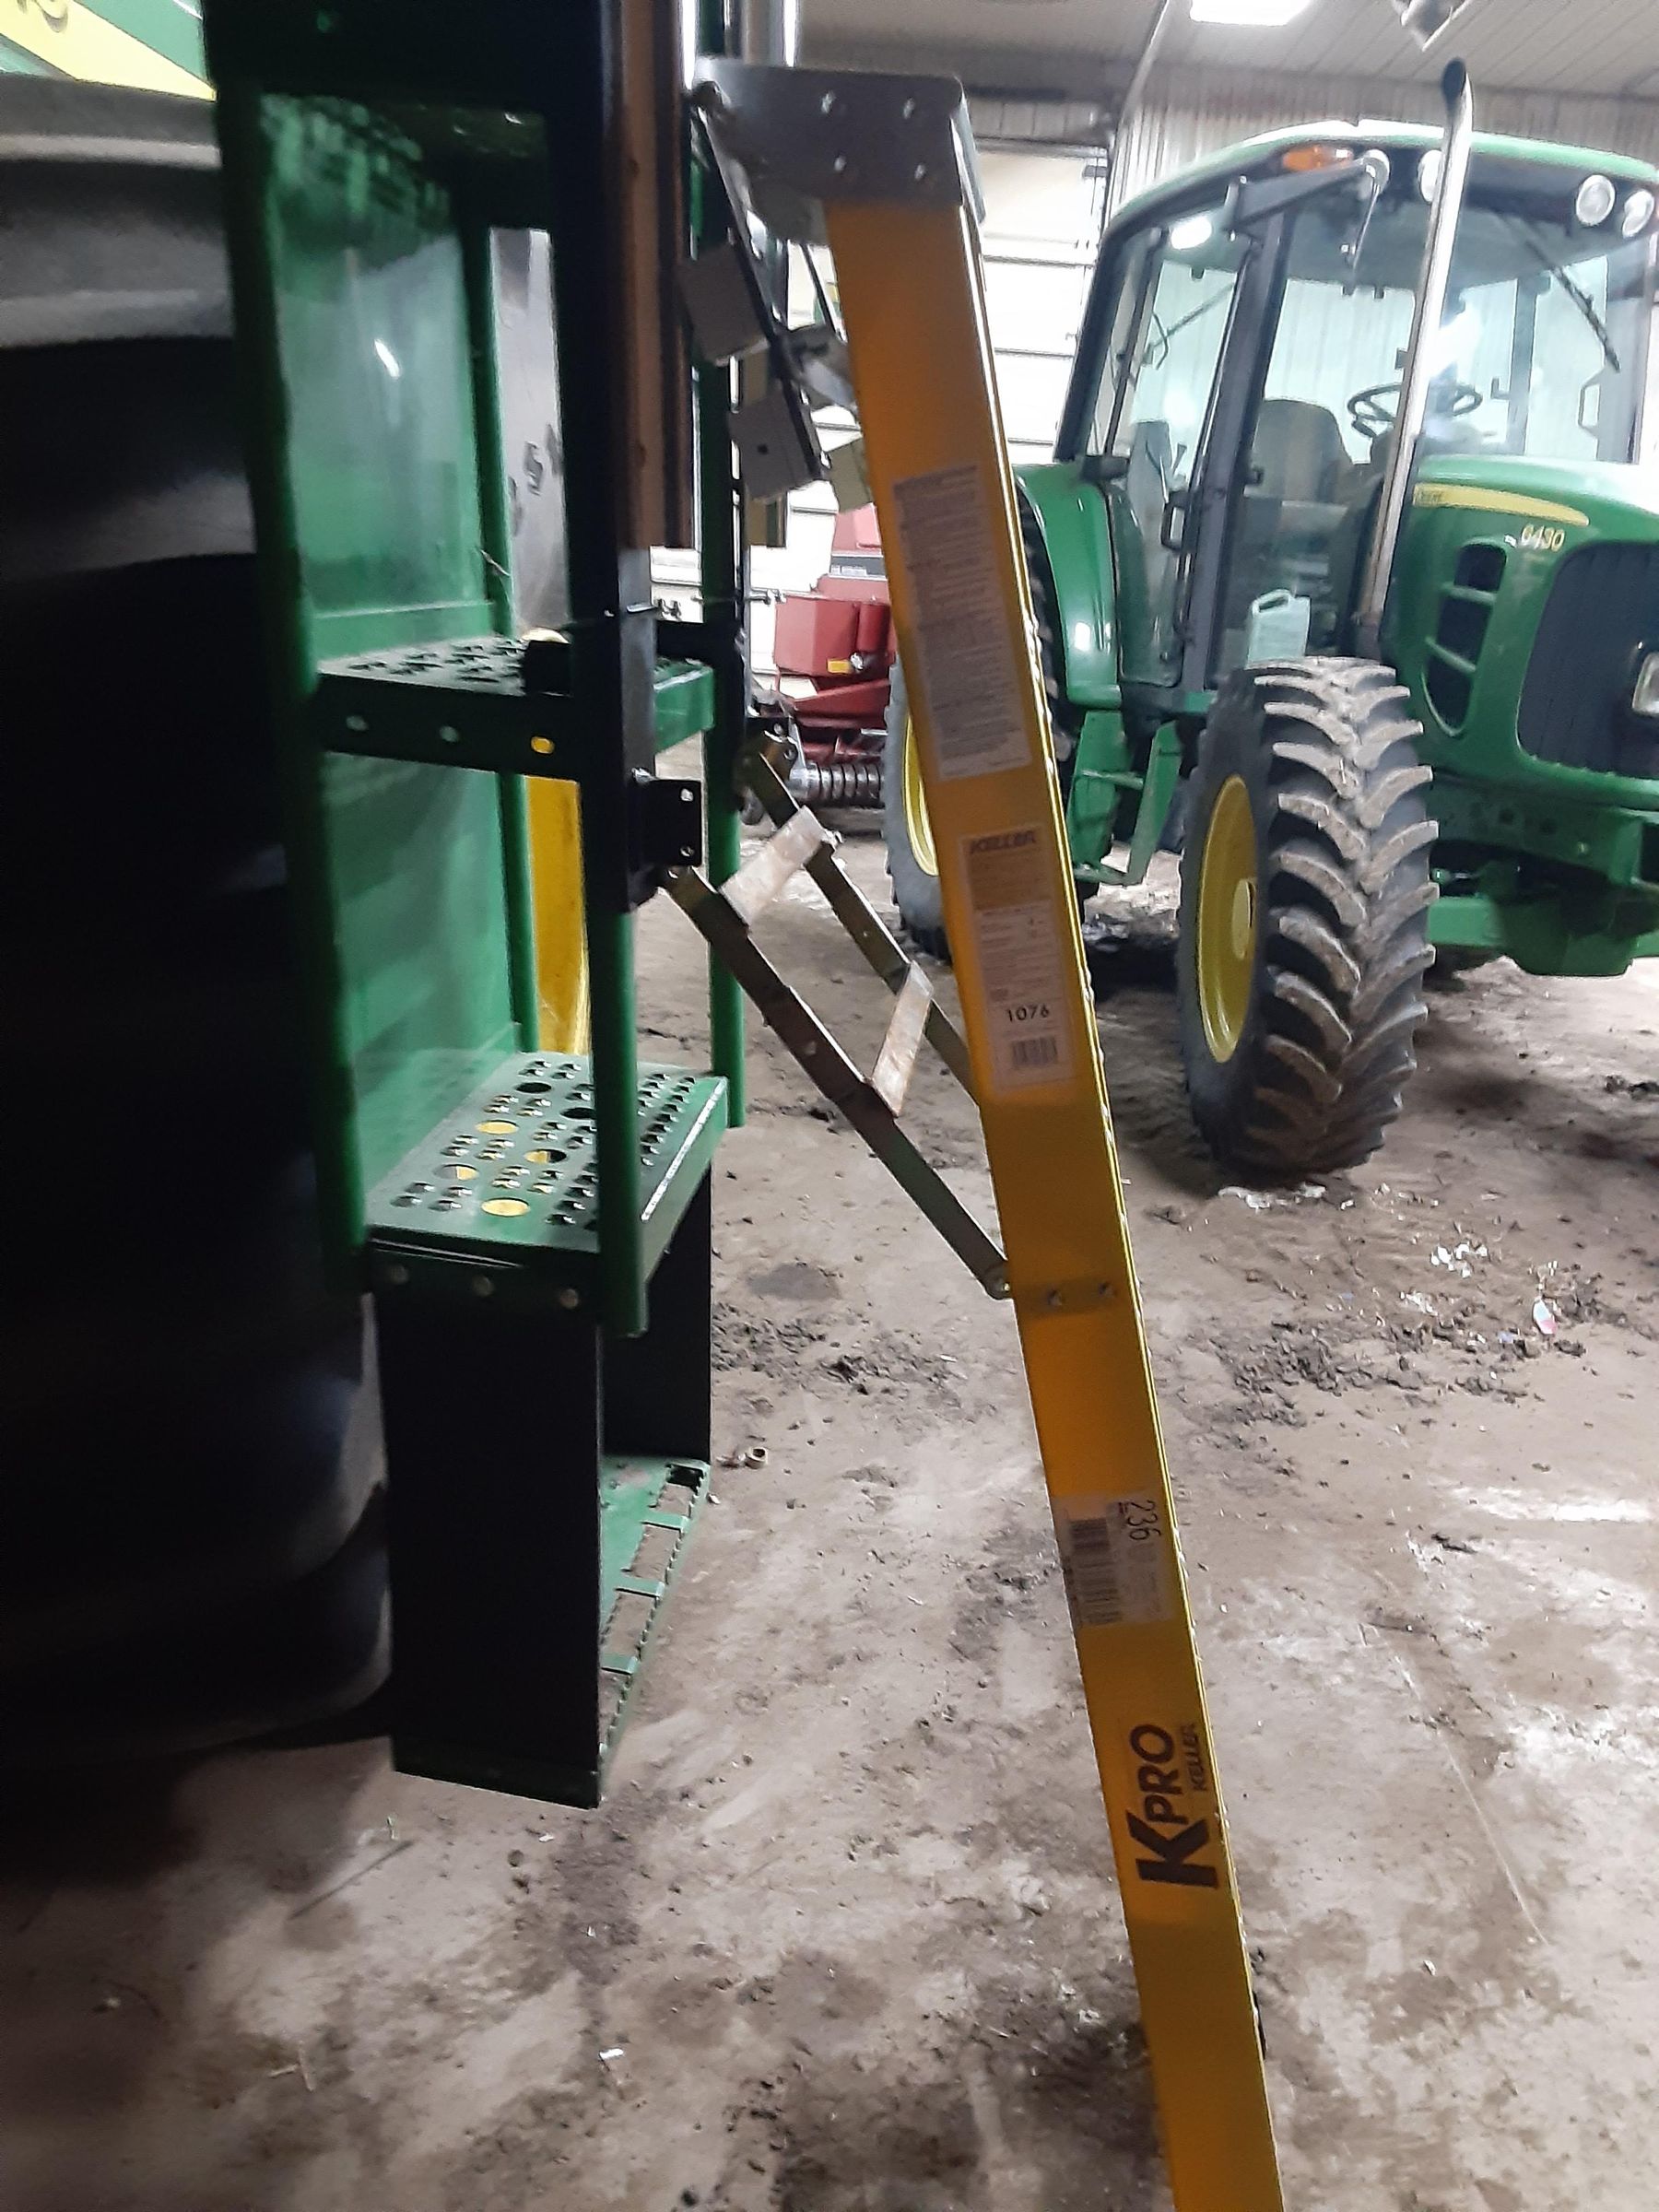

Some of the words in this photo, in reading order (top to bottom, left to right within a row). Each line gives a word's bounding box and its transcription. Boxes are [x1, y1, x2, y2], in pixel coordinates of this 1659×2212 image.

[1007, 1006, 1050, 1022] 1076
[1126, 1499, 1161, 1541] 236
[1181, 1722, 1209, 1793] KELLER
